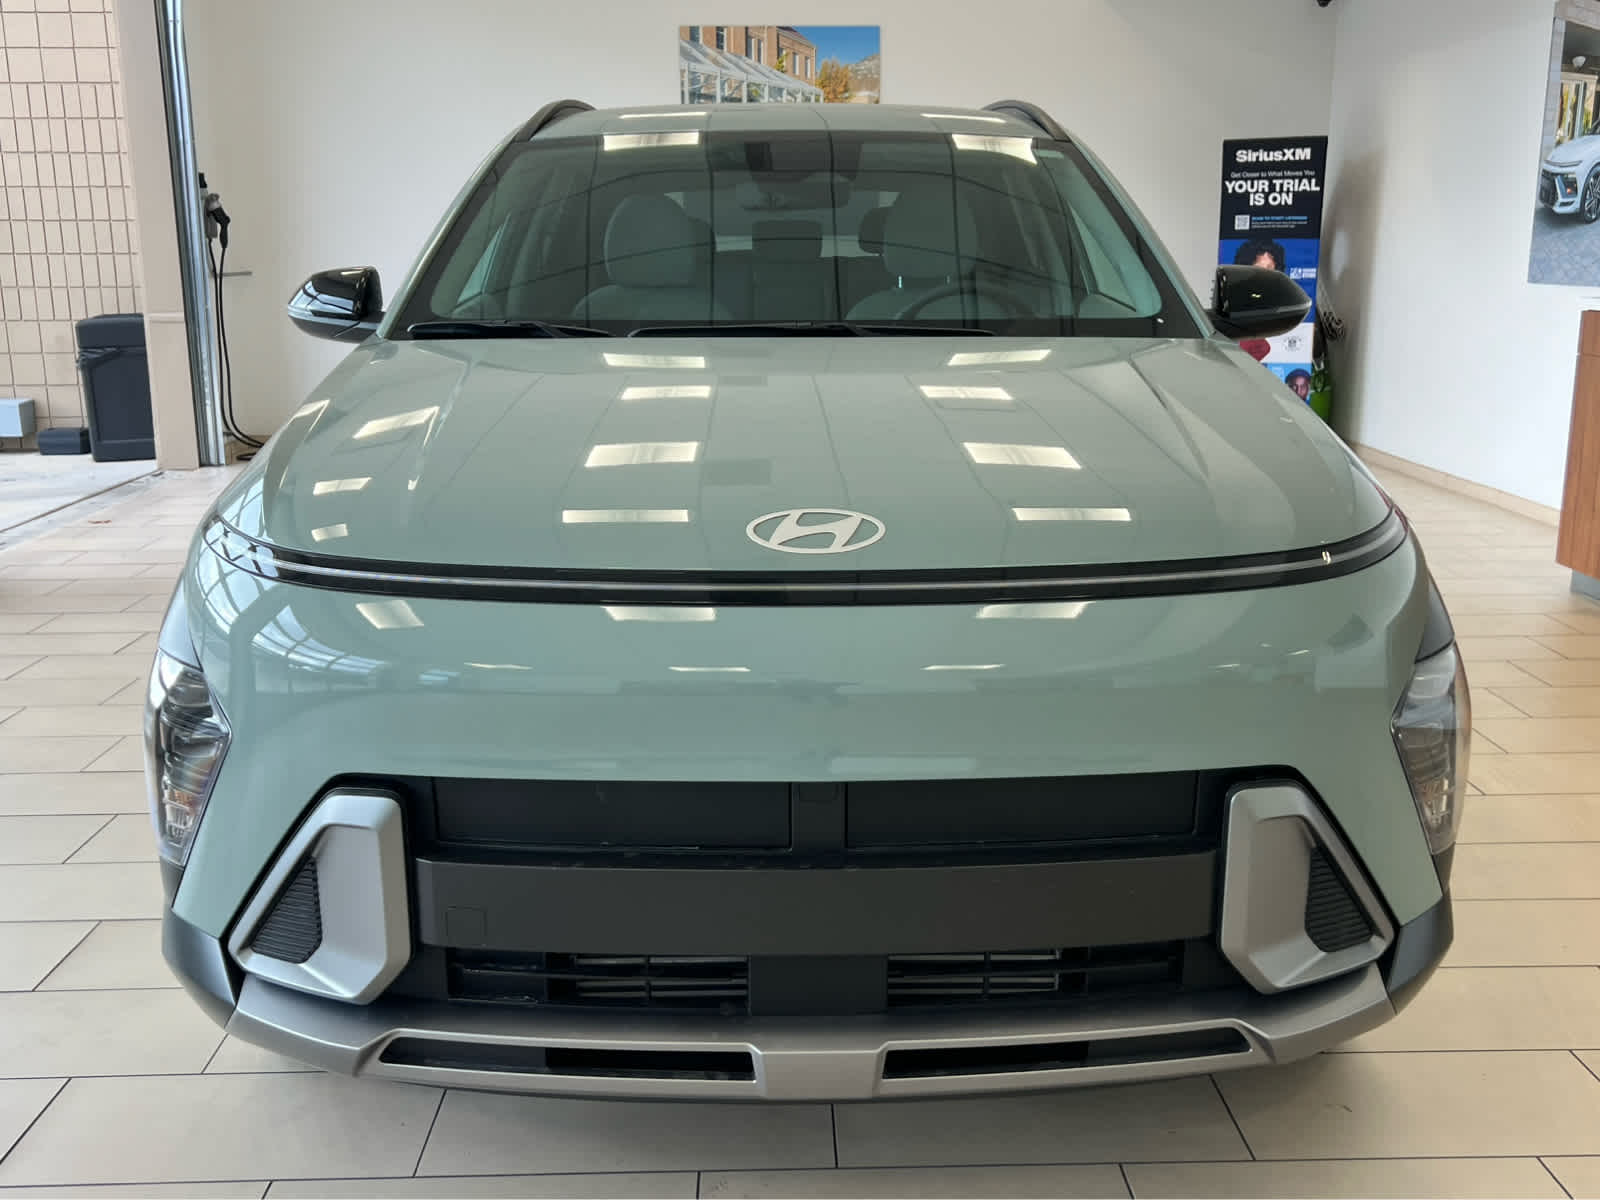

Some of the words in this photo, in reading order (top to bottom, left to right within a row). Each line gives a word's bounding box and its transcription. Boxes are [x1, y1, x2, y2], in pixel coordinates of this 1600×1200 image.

[1236, 148, 1311, 162] SiriusXM
[1225, 180, 1269, 193] YOUR
[1272, 178, 1320, 192] TRIAL
[1249, 193, 1264, 206] IS
[1268, 192, 1293, 205] ON
